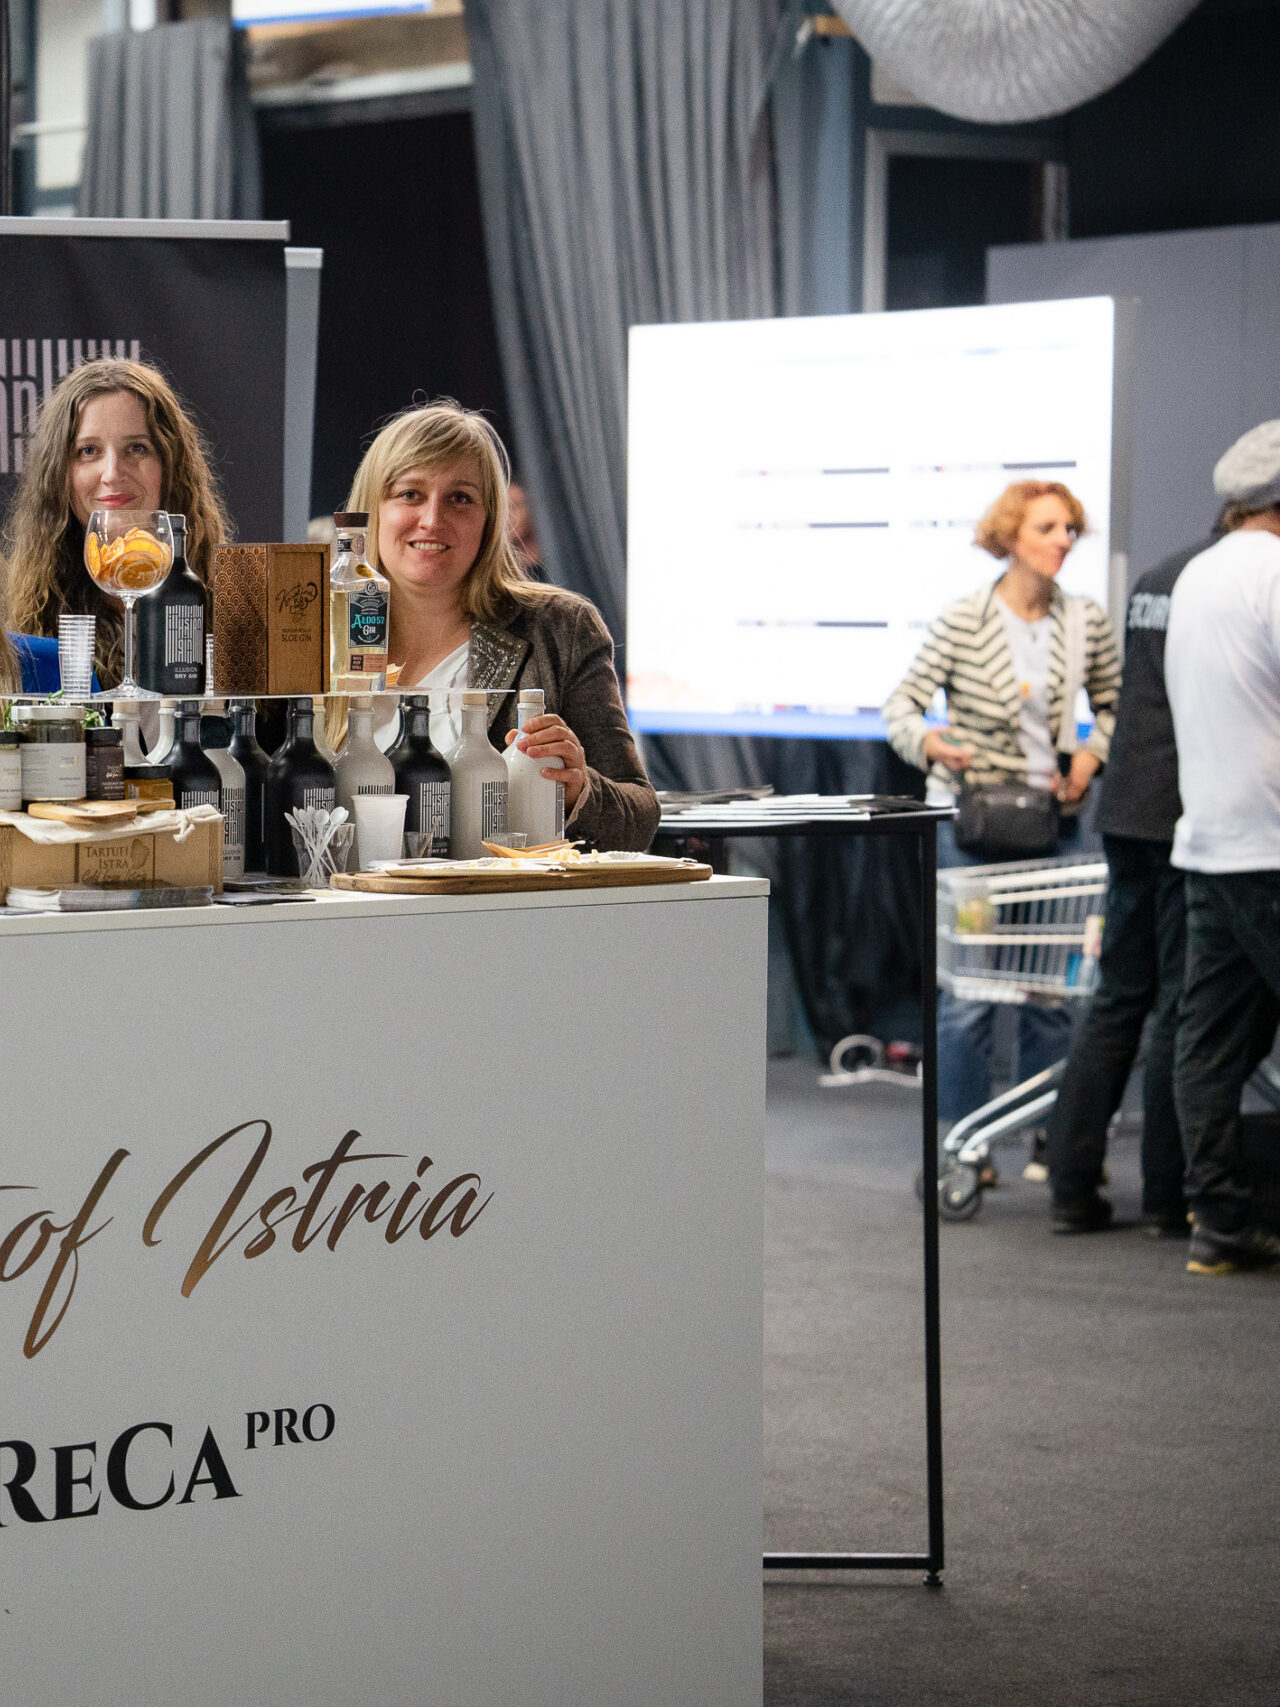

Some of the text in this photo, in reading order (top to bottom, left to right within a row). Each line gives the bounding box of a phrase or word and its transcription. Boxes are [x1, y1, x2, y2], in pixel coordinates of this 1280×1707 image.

[85, 845, 129, 858] TARTUFI
[98, 858, 129, 870] ISTRA
[142, 1118, 496, 1299] Istria
[245, 1402, 337, 1451] PRO
